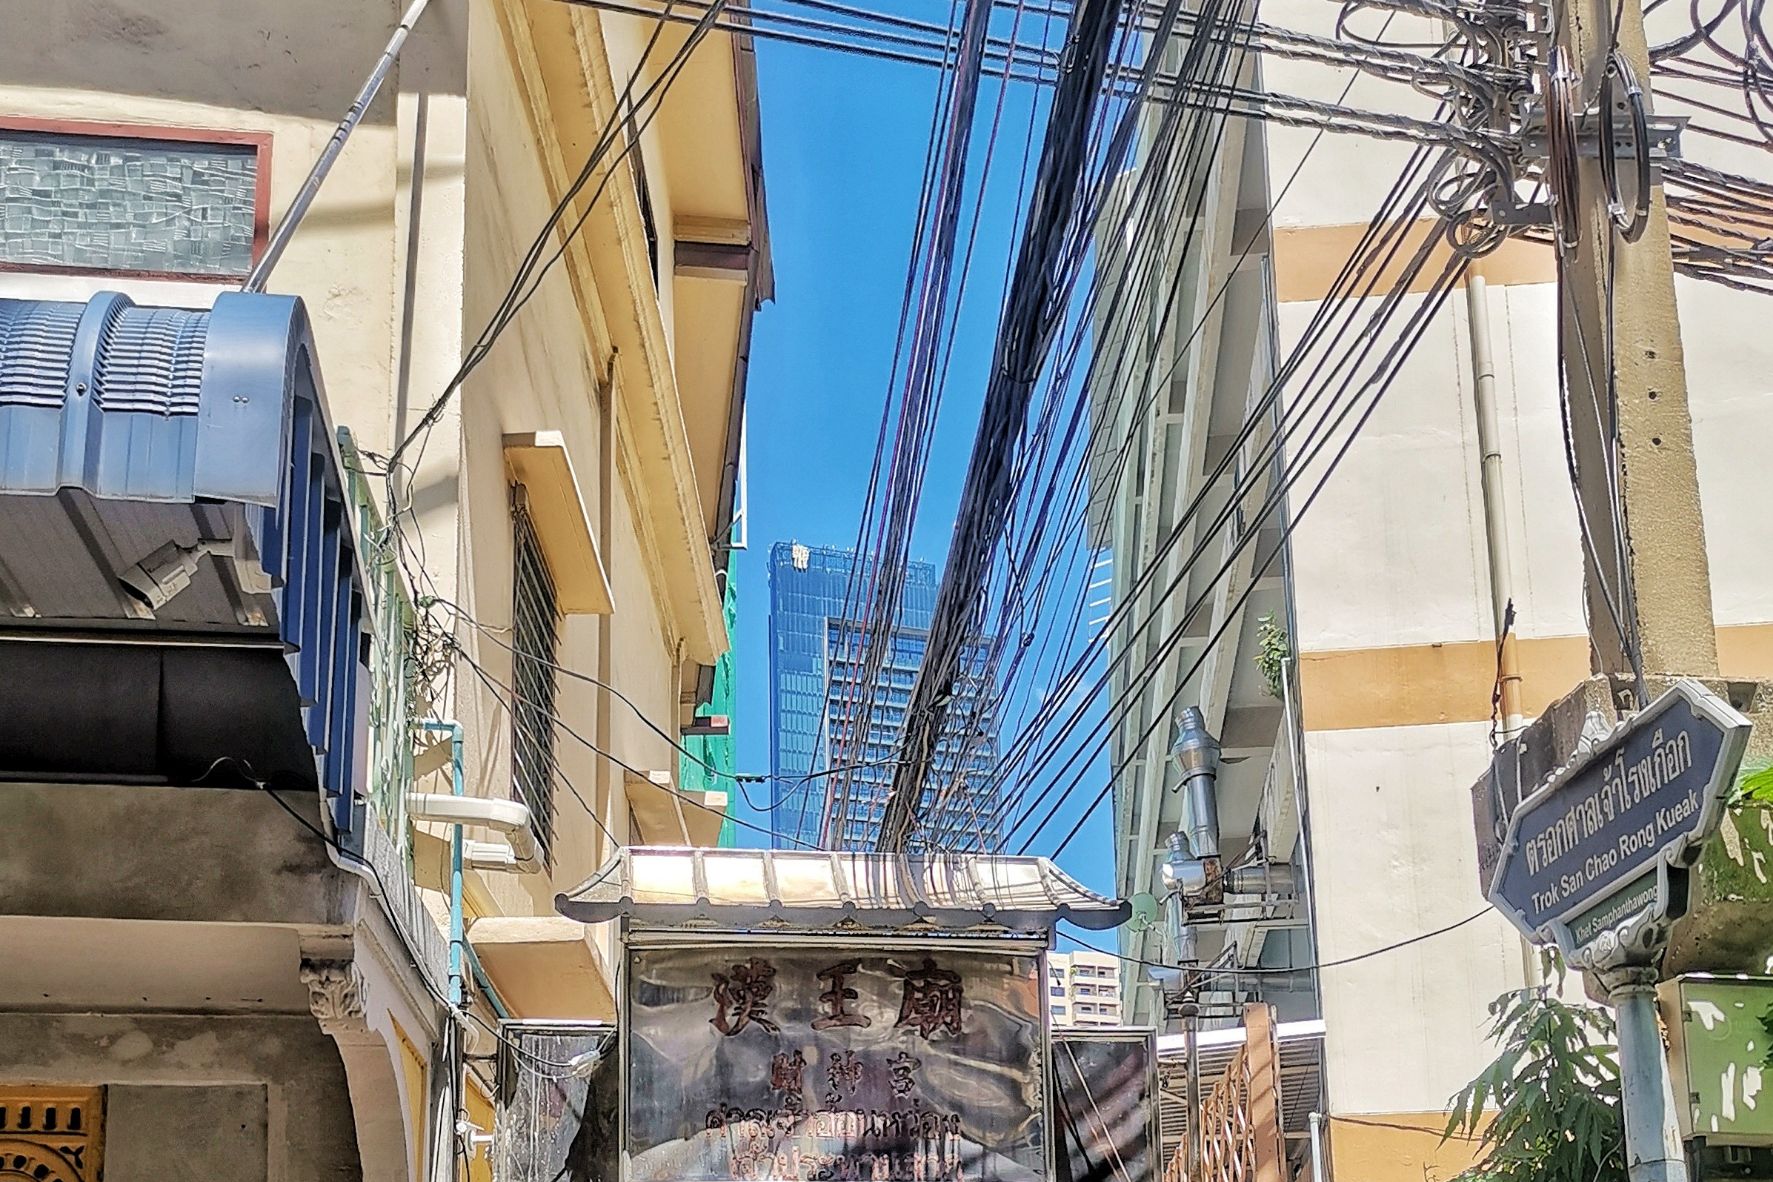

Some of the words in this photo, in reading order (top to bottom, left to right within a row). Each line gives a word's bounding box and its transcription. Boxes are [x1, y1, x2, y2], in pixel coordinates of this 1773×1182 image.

[1526, 728, 1692, 876] ตรอกศาลเจ้าโรงเกือก
[1532, 883, 1559, 914] Trok
[1560, 871, 1584, 898] San
[1586, 849, 1617, 883] Chao
[1619, 822, 1655, 860] Rong
[1656, 791, 1700, 835] Kueak
[1576, 921, 1592, 944] Khet
[1592, 885, 1658, 933] Samphanthawong
